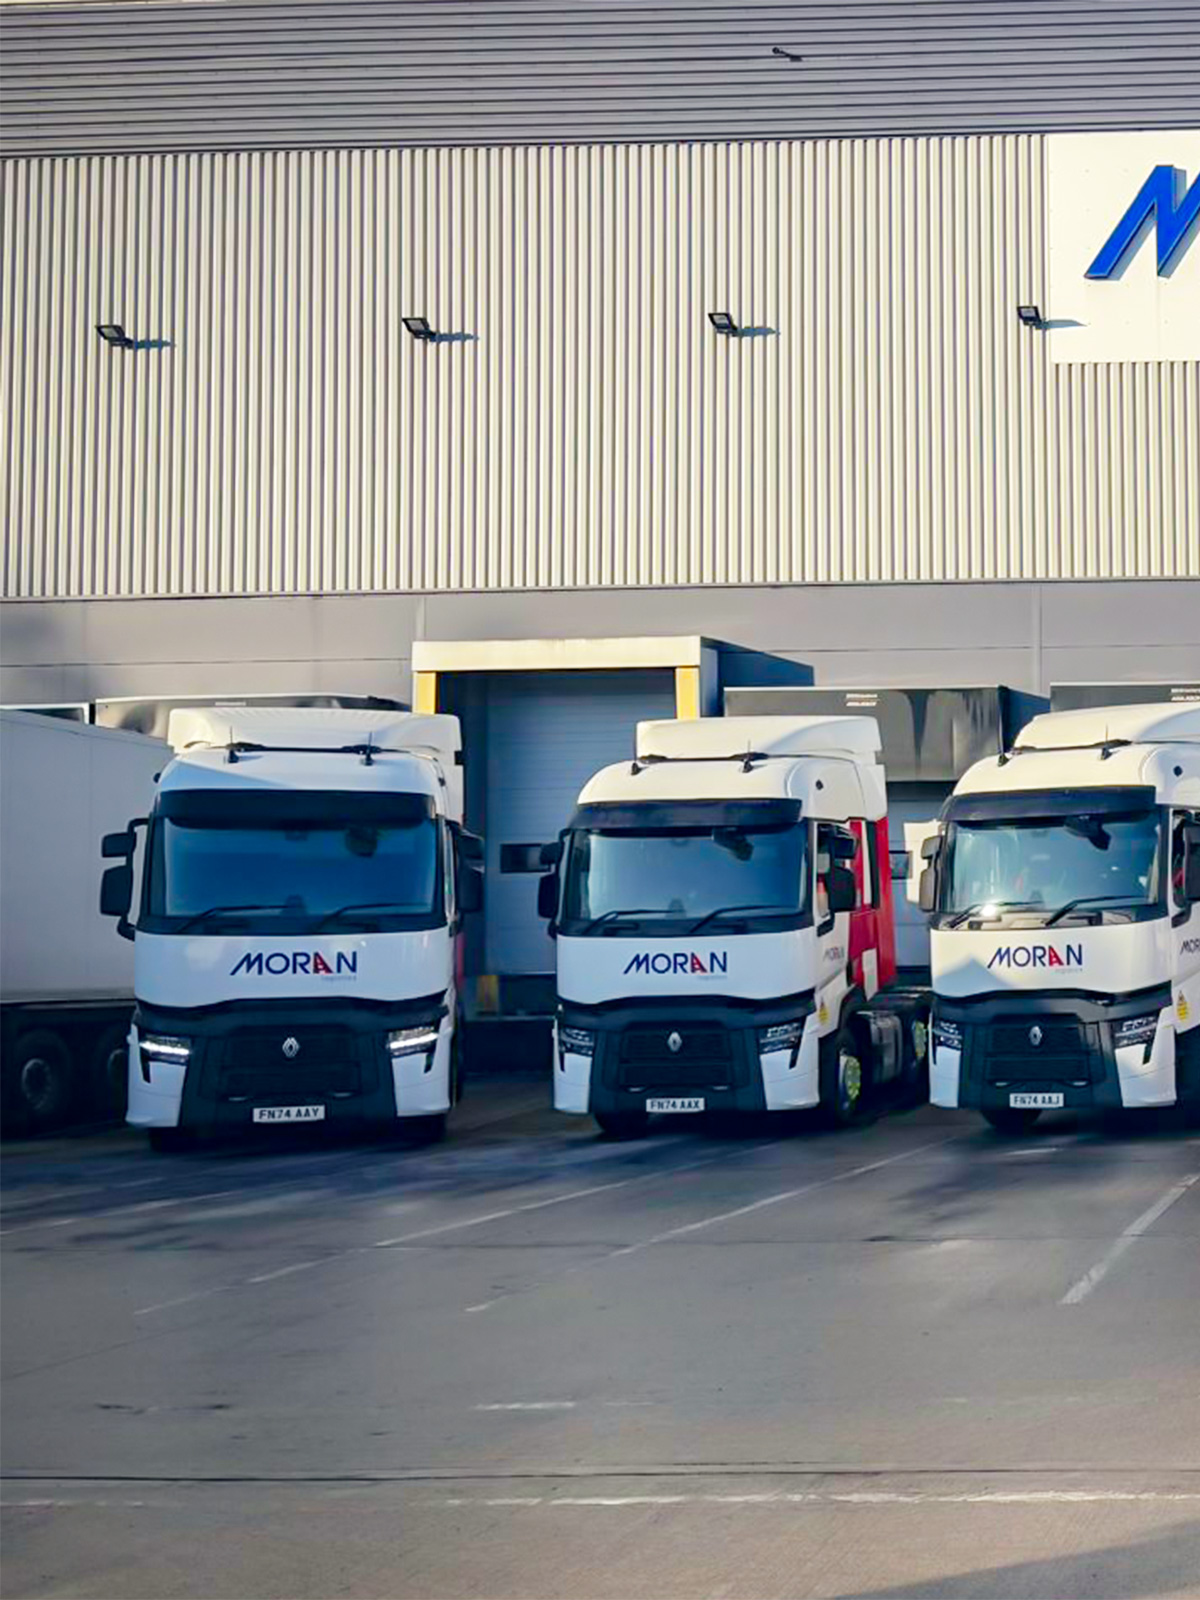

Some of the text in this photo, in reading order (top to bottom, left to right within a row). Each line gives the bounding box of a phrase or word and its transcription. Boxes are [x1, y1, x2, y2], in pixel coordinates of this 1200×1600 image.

[229, 950, 358, 976] MORAN
[623, 951, 728, 975] MORAN
[986, 943, 1083, 969] MORAN
